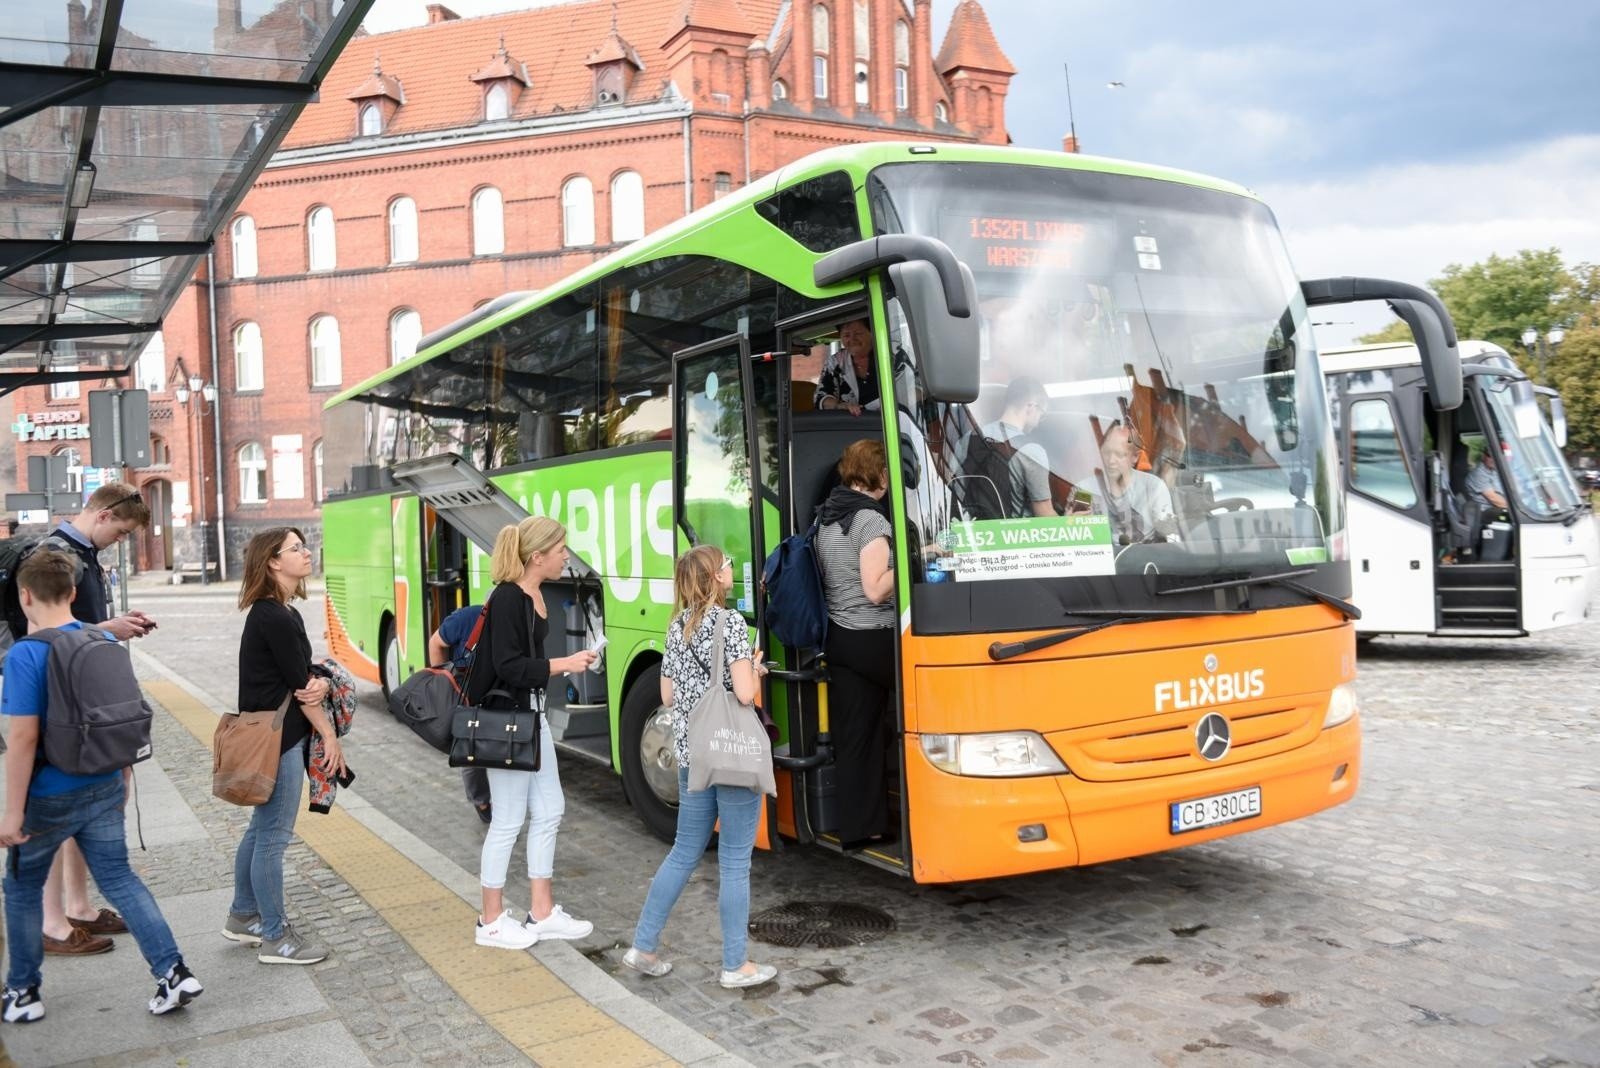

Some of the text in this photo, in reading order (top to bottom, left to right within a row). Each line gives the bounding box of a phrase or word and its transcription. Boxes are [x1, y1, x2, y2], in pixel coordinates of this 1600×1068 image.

[986, 246, 1073, 268] WARSZ
[33, 424, 91, 441] APTEK
[1001, 526, 1094, 545] WARSZAWA
[710, 740, 720, 752] NA
[1183, 791, 1257, 825] CB 380CE
